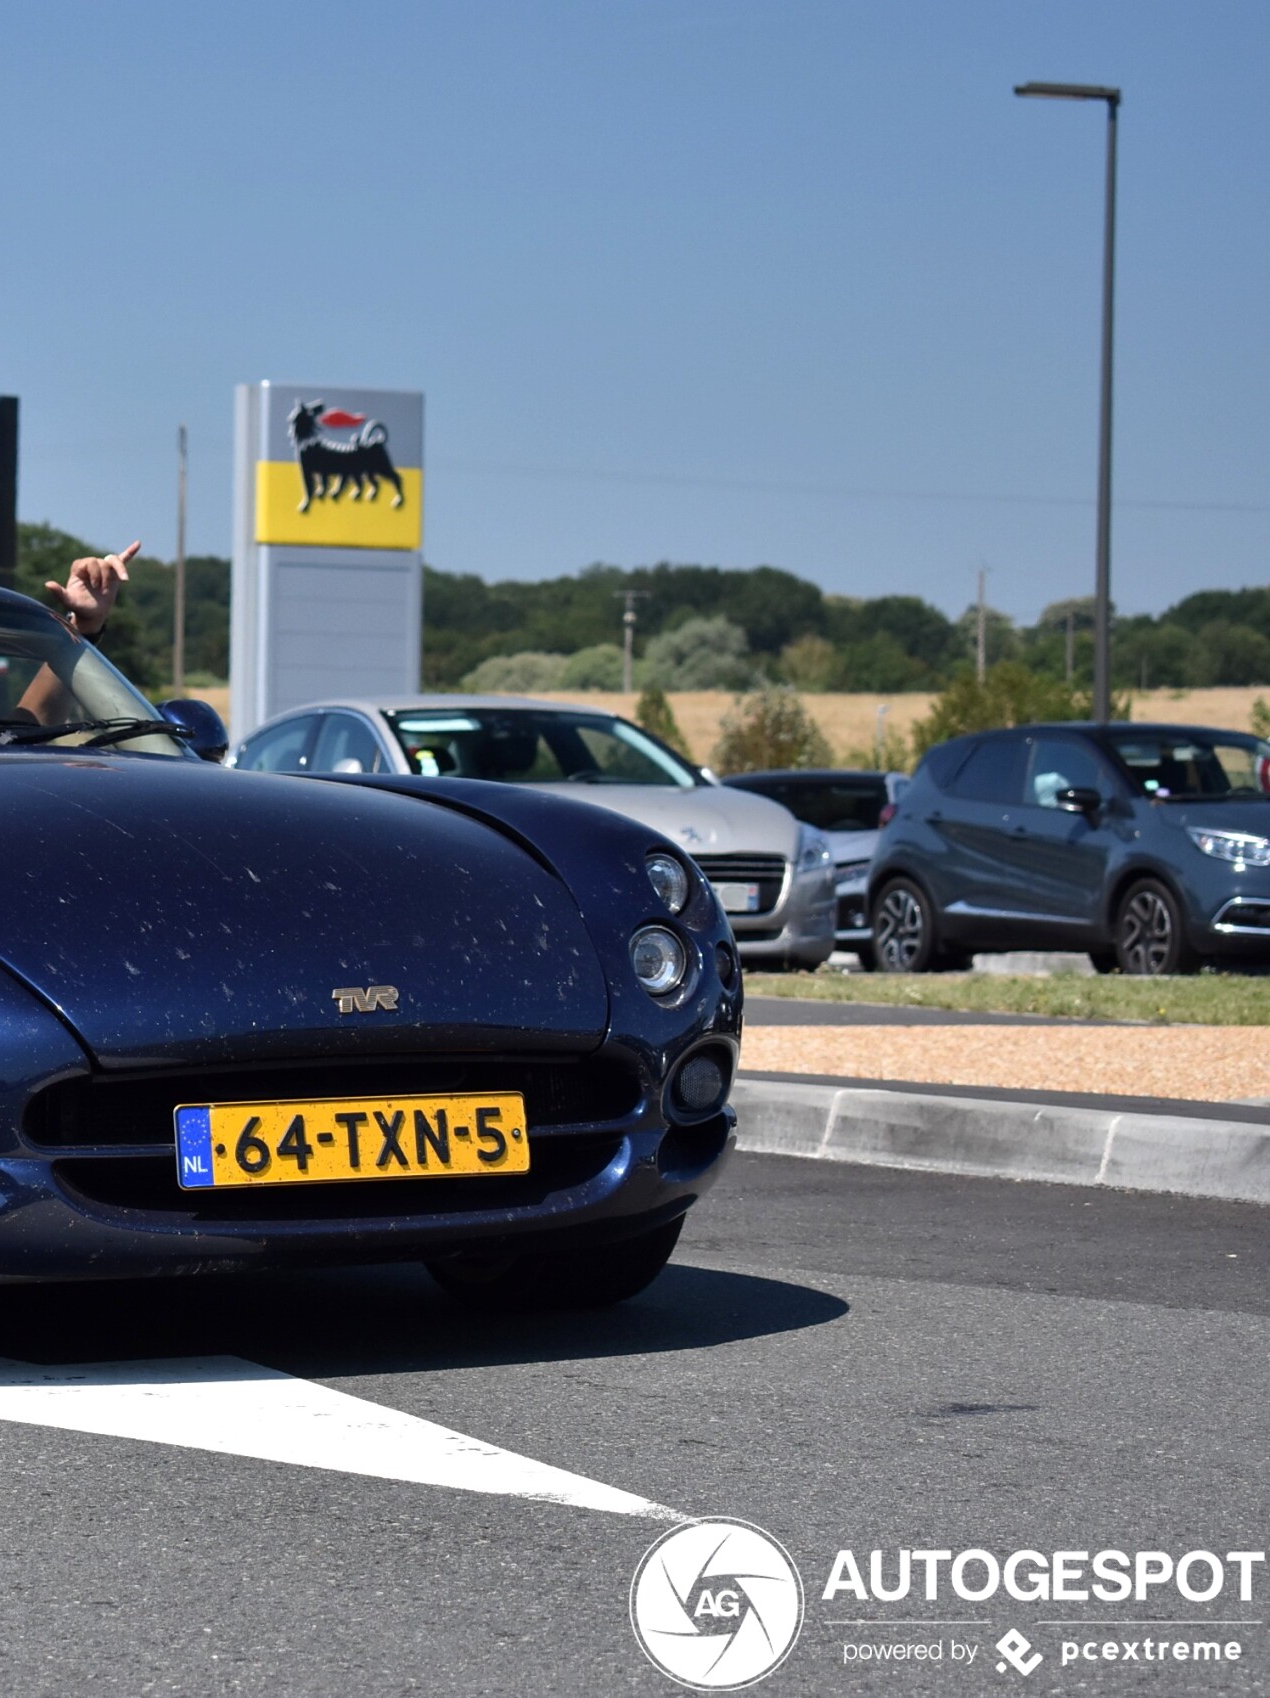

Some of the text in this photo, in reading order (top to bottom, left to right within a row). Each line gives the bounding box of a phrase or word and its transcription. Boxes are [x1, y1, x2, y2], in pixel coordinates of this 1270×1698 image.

[332, 985, 399, 1013] TVR
[235, 1107, 507, 1173] 64-TXN-5
[184, 1156, 208, 1173] NL
